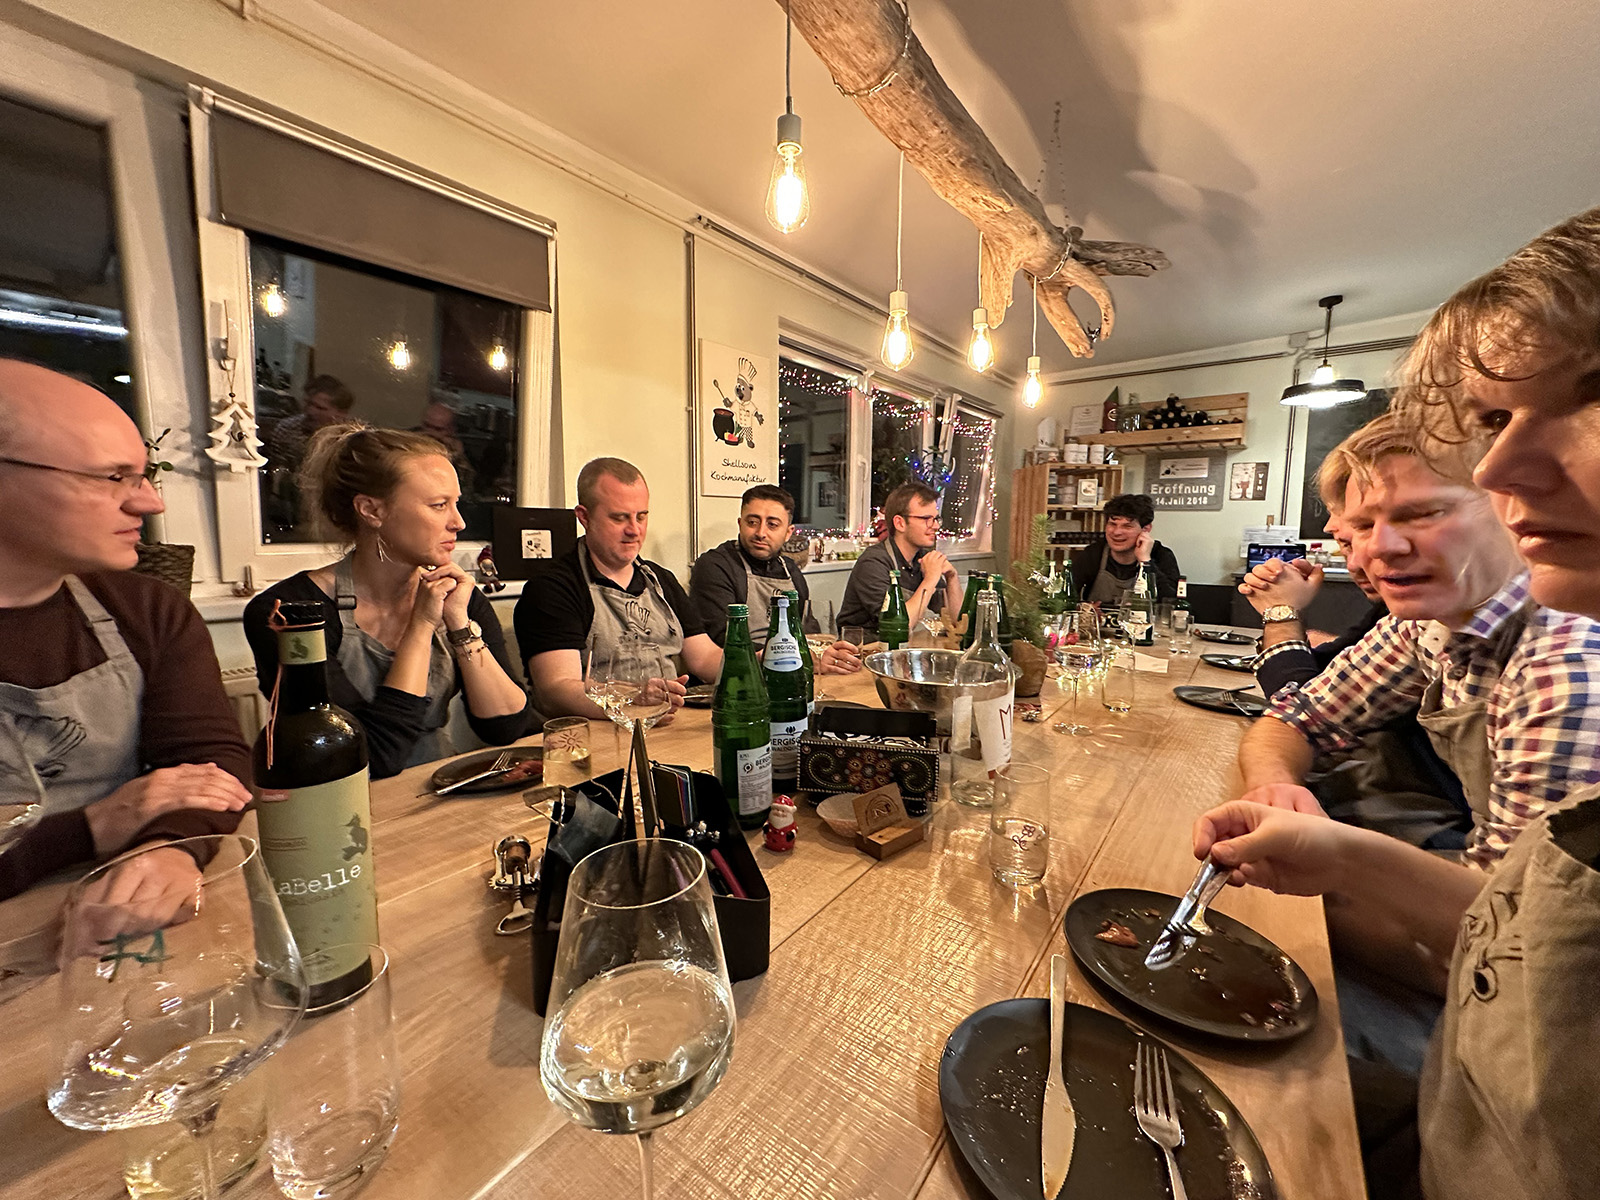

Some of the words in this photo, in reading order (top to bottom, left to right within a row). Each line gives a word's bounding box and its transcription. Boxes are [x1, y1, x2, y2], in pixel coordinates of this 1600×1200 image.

[722, 458, 757, 470] Shellsons
[711, 470, 767, 485] Kochmanufaktur
[1150, 483, 1216, 496] Eröffnung
